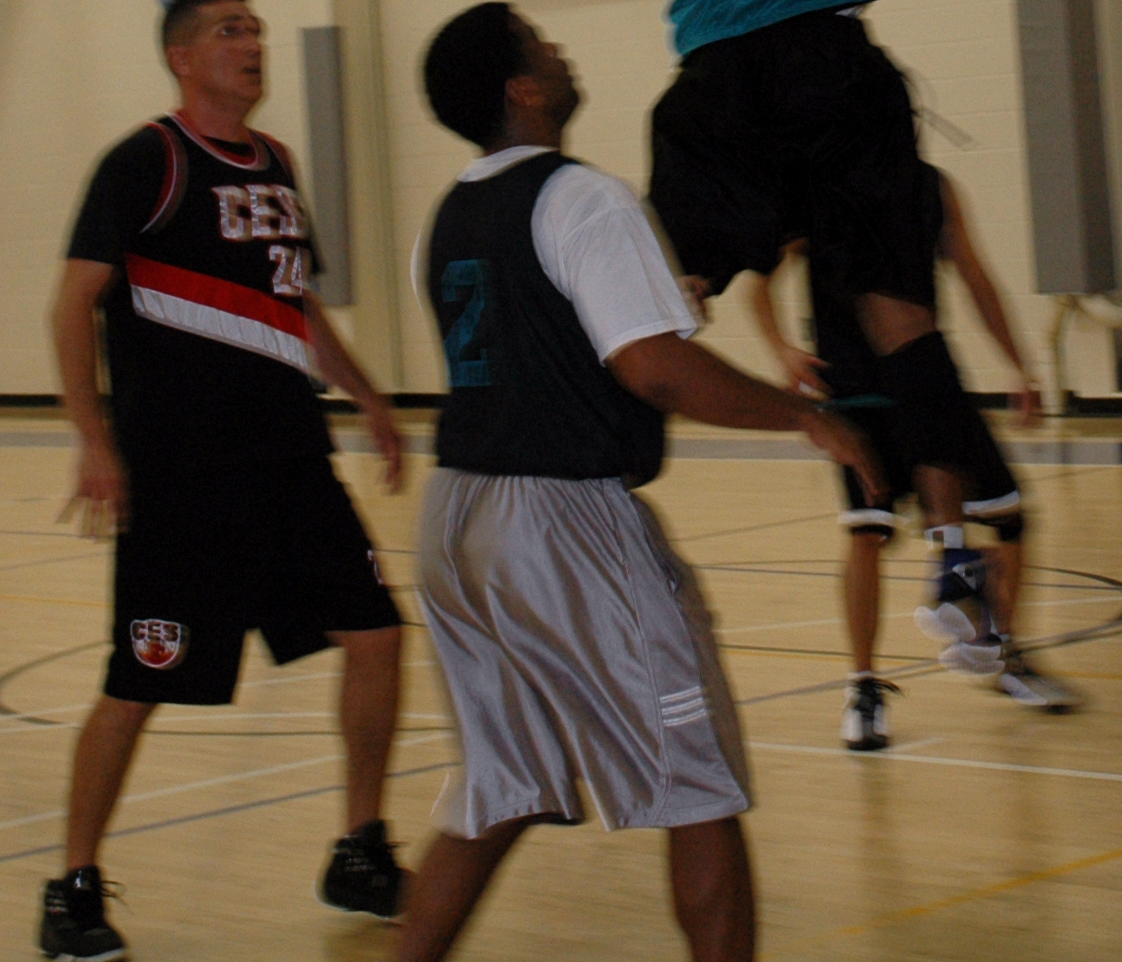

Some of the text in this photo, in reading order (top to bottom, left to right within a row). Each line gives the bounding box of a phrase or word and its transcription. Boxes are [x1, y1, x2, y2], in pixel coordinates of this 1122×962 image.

[268, 244, 307, 297] 24
[440, 258, 491, 387] 2
[131, 621, 180, 642] CES
